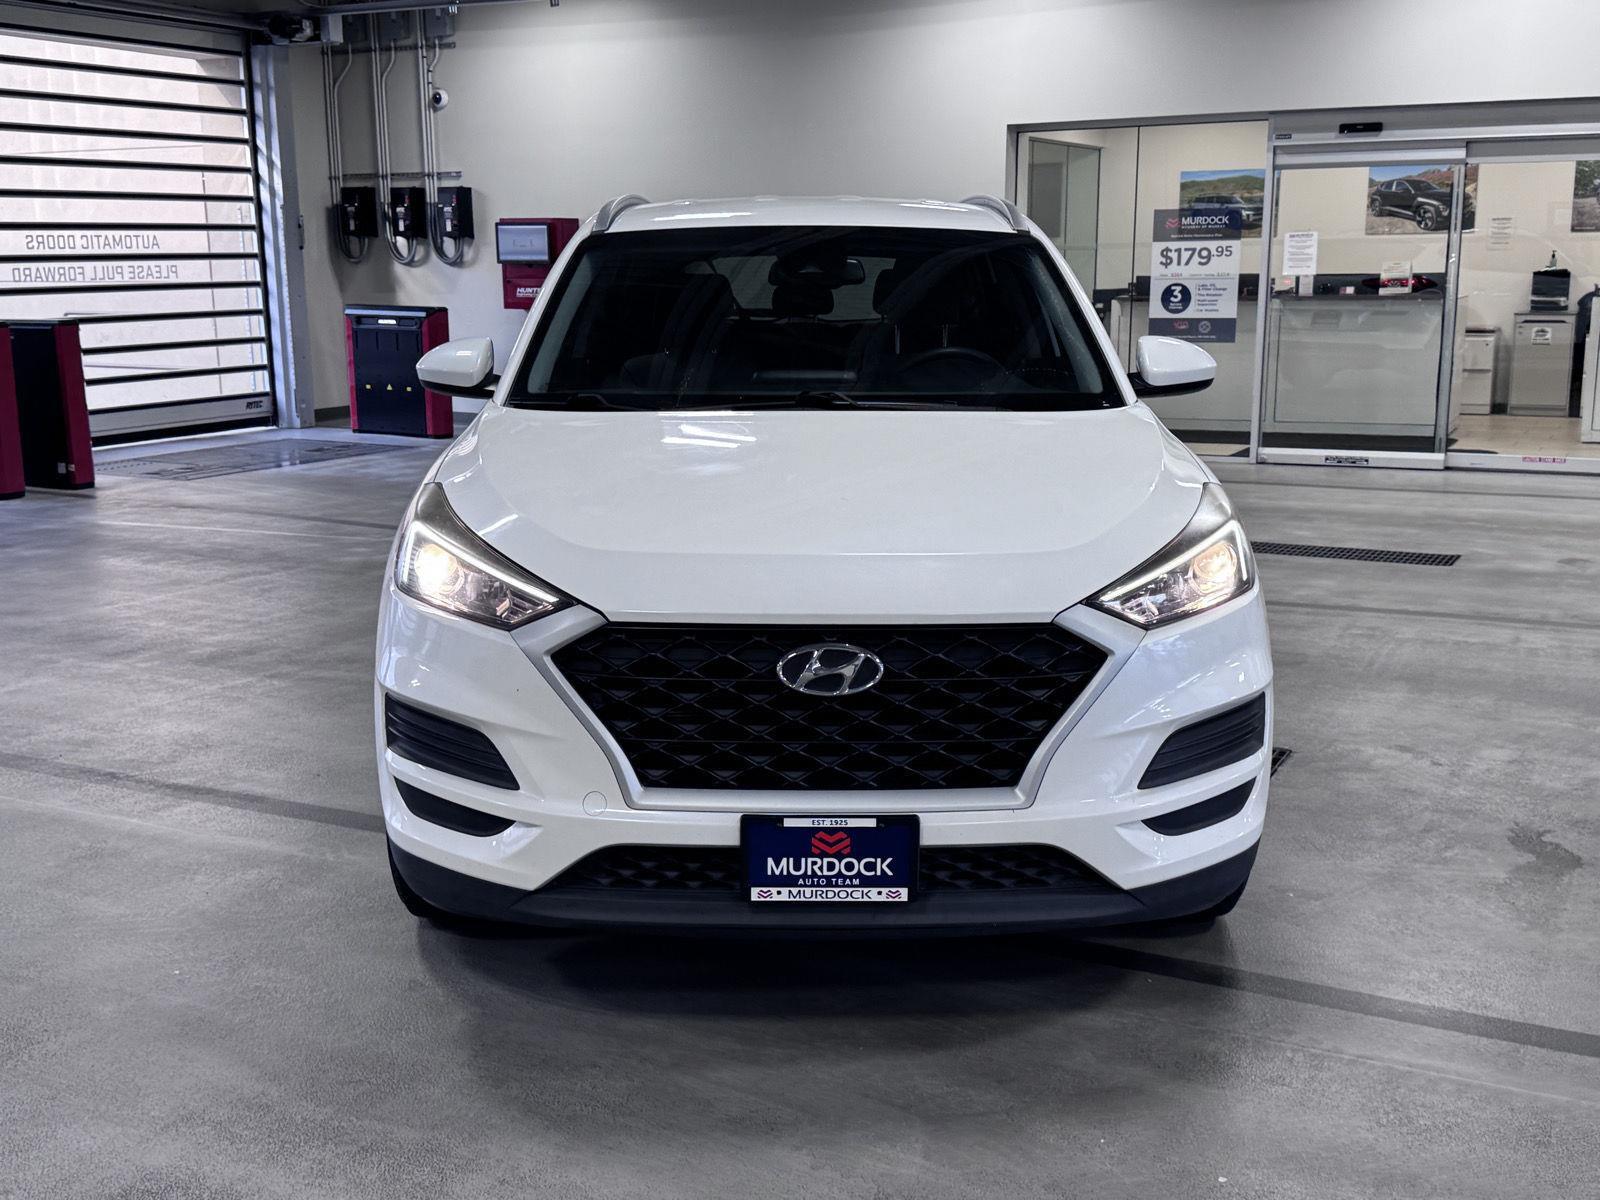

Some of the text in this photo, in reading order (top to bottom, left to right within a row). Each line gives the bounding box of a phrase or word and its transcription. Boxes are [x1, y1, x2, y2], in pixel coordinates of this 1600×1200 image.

[1181, 216, 1229, 225] MURDOCK
[1159, 246, 1233, 268] $179.95
[1170, 285, 1182, 302] 3
[767, 857, 894, 876] MURDOCK
[798, 878, 860, 886] AUTO TEAM
[788, 889, 873, 899] MURDOCK
